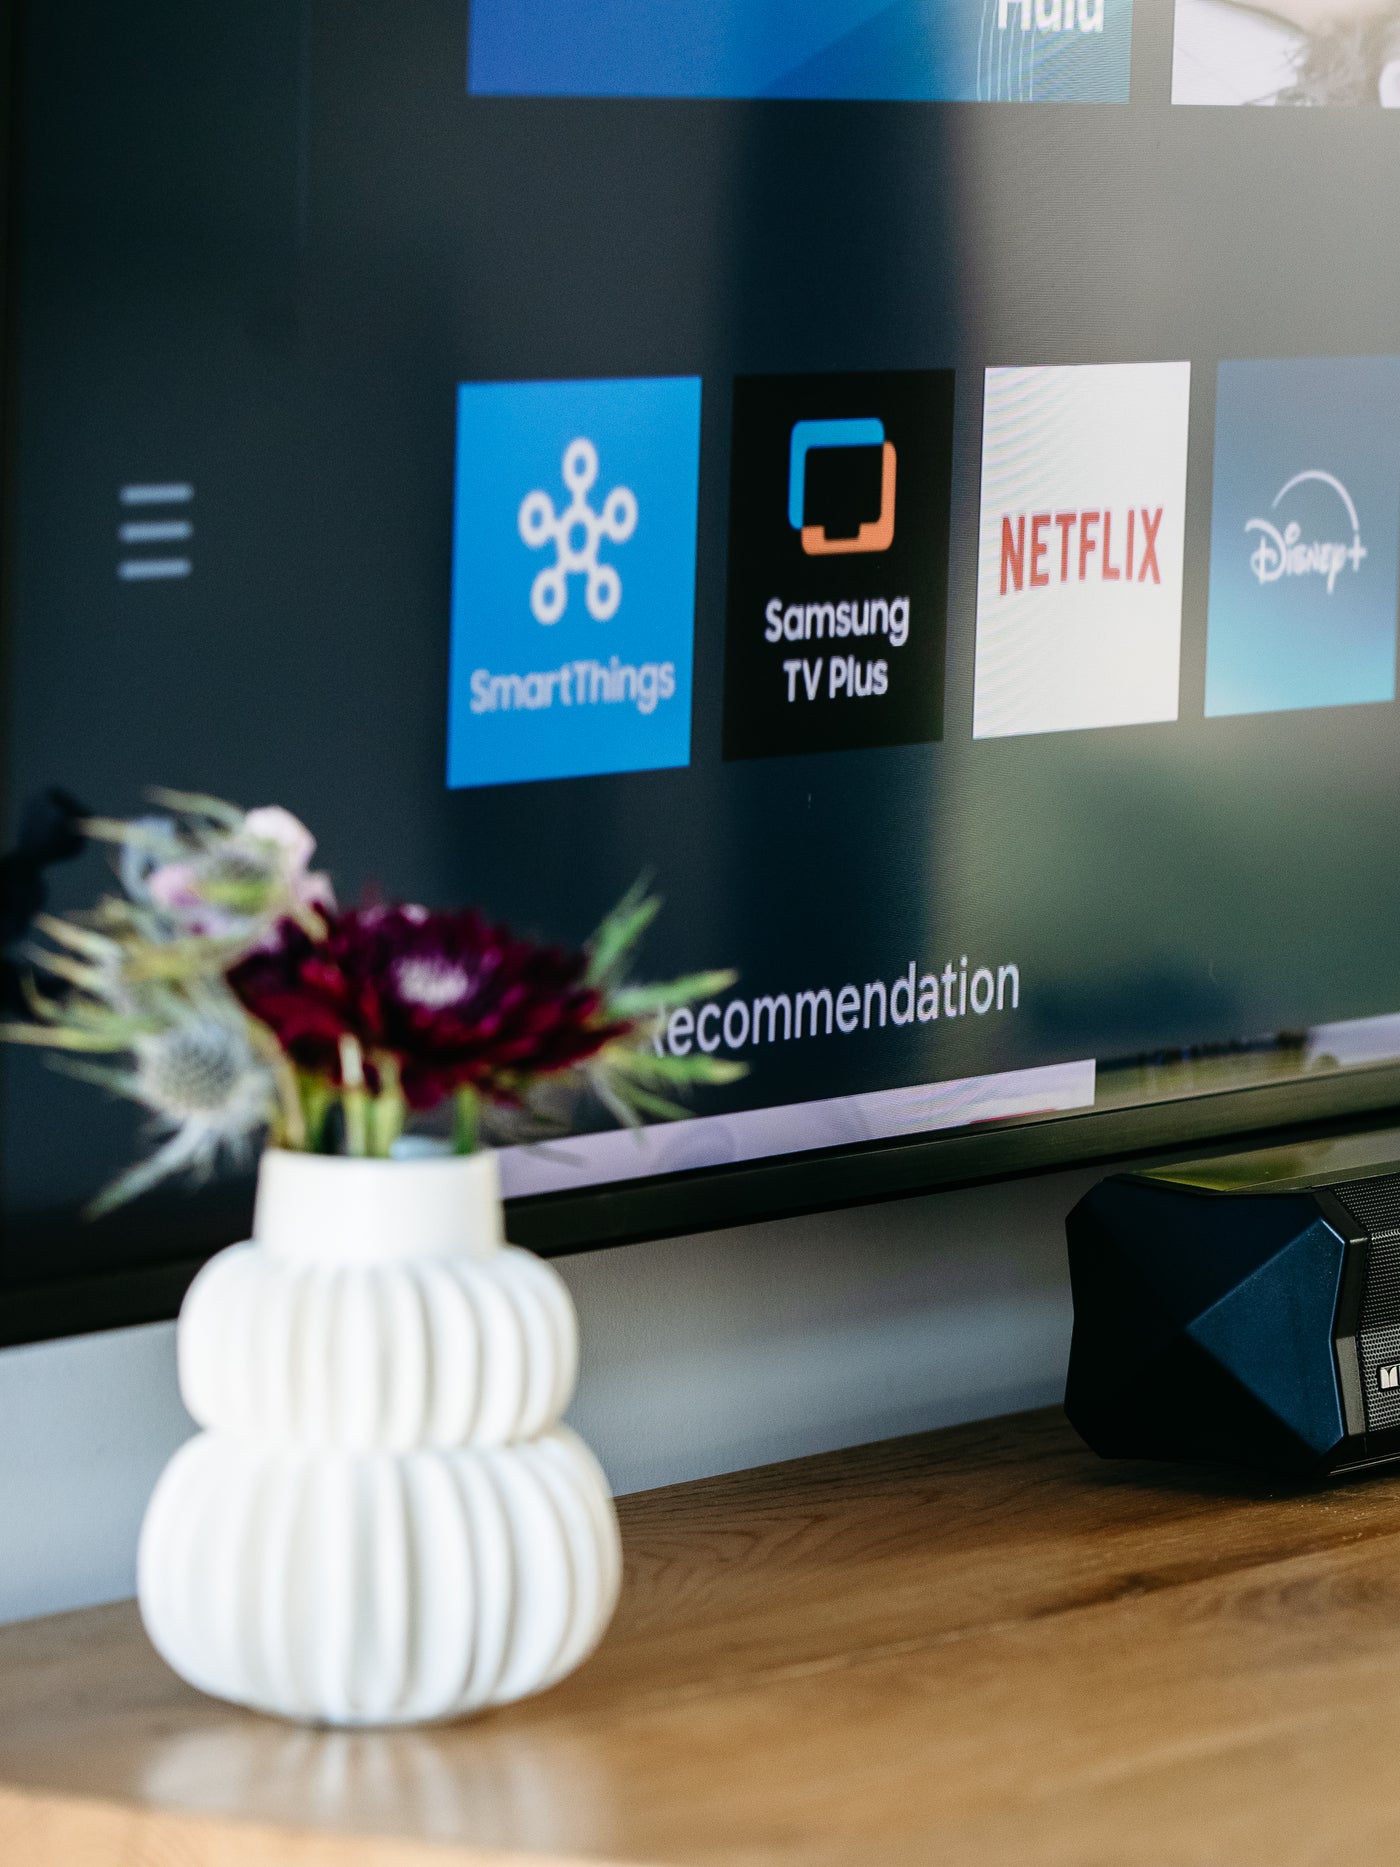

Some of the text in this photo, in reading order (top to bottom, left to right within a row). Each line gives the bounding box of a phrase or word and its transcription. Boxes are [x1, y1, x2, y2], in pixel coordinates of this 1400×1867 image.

[1000, 508, 1163, 595] NETFLIX
[764, 597, 910, 647] Samsung
[470, 655, 675, 714] SmartThings
[783, 654, 889, 702] TV Plus
